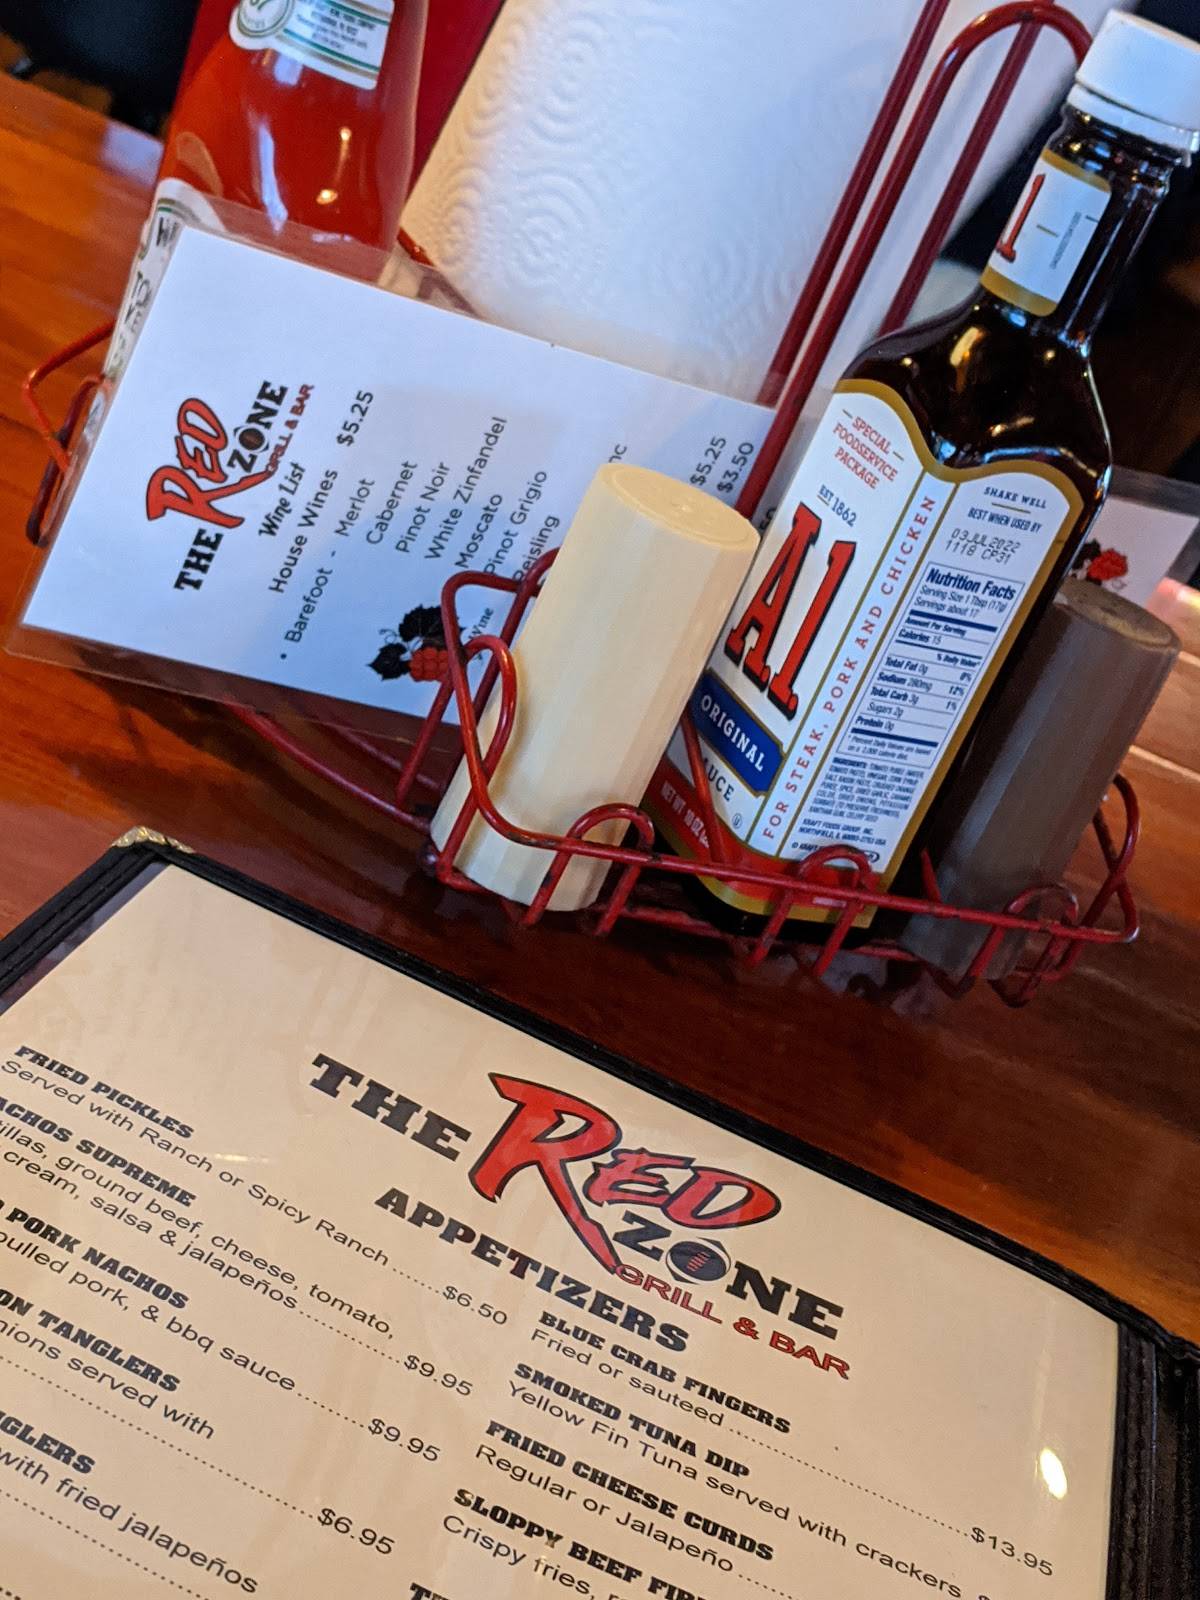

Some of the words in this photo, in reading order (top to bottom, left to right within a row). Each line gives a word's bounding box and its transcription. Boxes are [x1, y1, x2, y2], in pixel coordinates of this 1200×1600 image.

[145, 397, 246, 529] RED
[227, 380, 288, 473] ZONE
[689, 436, 727, 487] $5.25
[716, 442, 754, 494] $3.50
[833, 423, 898, 482] FOODSERVICE
[835, 447, 880, 490] PACKAGE
[852, 416, 891, 455] SPECIAL
[258, 497, 292, 537] Wine
[278, 461, 306, 496] List
[268, 535, 309, 593] House
[297, 469, 338, 529] Wines
[336, 390, 374, 447] $5.25
[365, 460, 418, 546] Cabernet
[395, 505, 431, 554] Pinot
[419, 462, 450, 502] Noir
[424, 508, 463, 561] White
[453, 416, 508, 505] Zinfandel
[455, 494, 503, 569] Moscato
[483, 529, 519, 578] Pinot
[510, 471, 548, 526] Grigio
[819, 484, 835, 502] EST
[831, 498, 857, 527] 1862
[967, 507, 988, 520] BEST
[983, 486, 1018, 502] SHAKE
[1021, 494, 1047, 509] WELL
[174, 528, 223, 590] THE
[284, 566, 334, 644] Barefoot
[334, 477, 376, 538] Merlot
[926, 567, 981, 596] Nutrition
[982, 580, 1018, 602] Facts
[763, 801, 790, 840] FOR
[822, 657, 858, 714] PORK
[855, 604, 883, 650] AND
[880, 496, 937, 595] CHICKEN
[701, 695, 765, 773] ORIGINAL
[704, 757, 735, 802] UCE
[14, 1045, 91, 1086] FRIED
[90, 1081, 195, 1140] PICKLES
[309, 1052, 473, 1162] THE
[1, 1060, 85, 1106] Served
[89, 1101, 134, 1132] with
[138, 1126, 213, 1173] Ranch
[218, 1170, 245, 1188] or
[247, 1183, 311, 1224] Spicy
[314, 1218, 389, 1267] Ranch
[442, 1284, 508, 1326] $6.50
[75, 1138, 197, 1208] SUPREME
[467, 1071, 782, 1276] RED
[0, 1121, 48, 1160] illas,
[55, 1155, 145, 1204] ground
[145, 1198, 204, 1240] beef,
[210, 1234, 300, 1291] cheese,
[308, 1283, 394, 1340] tomato,
[4, 1150, 79, 1201] cream,
[90, 1195, 153, 1235] salsa
[159, 1229, 177, 1248] &
[178, 1240, 299, 1310] jalapeños
[403, 1354, 474, 1397] $9.95
[5, 1207, 82, 1255] PORK
[81, 1247, 189, 1310] NACHOS
[373, 1187, 690, 1353] APPETIZERS
[612, 1209, 845, 1341] ZONE
[37, 1309, 181, 1393] TANGLERS
[68, 1270, 129, 1312] pork,
[141, 1304, 160, 1323] &
[166, 1315, 215, 1354] bbq
[219, 1346, 296, 1391] sauce
[367, 1418, 441, 1462] $9.95
[538, 1310, 607, 1352] BLUE
[609, 1343, 678, 1384] CRAB
[682, 1375, 791, 1435] FINGERS
[614, 1263, 723, 1326] GRILL
[733, 1316, 761, 1341] &
[768, 1330, 851, 1381] BAR
[0, 1410, 96, 1475] GLERS
[67, 1356, 159, 1409] served
[163, 1404, 215, 1441] with
[317, 1507, 395, 1556] $6.95
[513, 1362, 622, 1422] SMOKED
[627, 1412, 698, 1458] TUNA
[703, 1448, 751, 1479] DIP
[530, 1327, 593, 1367] Fried
[597, 1360, 624, 1380] or
[628, 1375, 725, 1428] sauteed
[970, 1526, 1054, 1578] $13.95
[0, 1447, 50, 1486] with
[55, 1477, 122, 1521] fried
[117, 1511, 259, 1595] jalapeños
[442, 1514, 528, 1567] Crispy
[453, 1487, 565, 1550] SLOPPY
[567, 1540, 644, 1584] BEEF
[474, 1444, 578, 1502] Regular
[581, 1496, 612, 1517] or
[614, 1510, 735, 1574] Jalapeño
[484, 1419, 568, 1469] FRIED
[570, 1459, 680, 1520] CHEESE
[682, 1510, 775, 1562] CURDS
[508, 1379, 585, 1427] Yellow
[590, 1419, 629, 1450] Fin
[638, 1439, 699, 1482] Tuna
[704, 1473, 791, 1522] served
[798, 1513, 848, 1547] with
[855, 1541, 962, 1599] crackers
